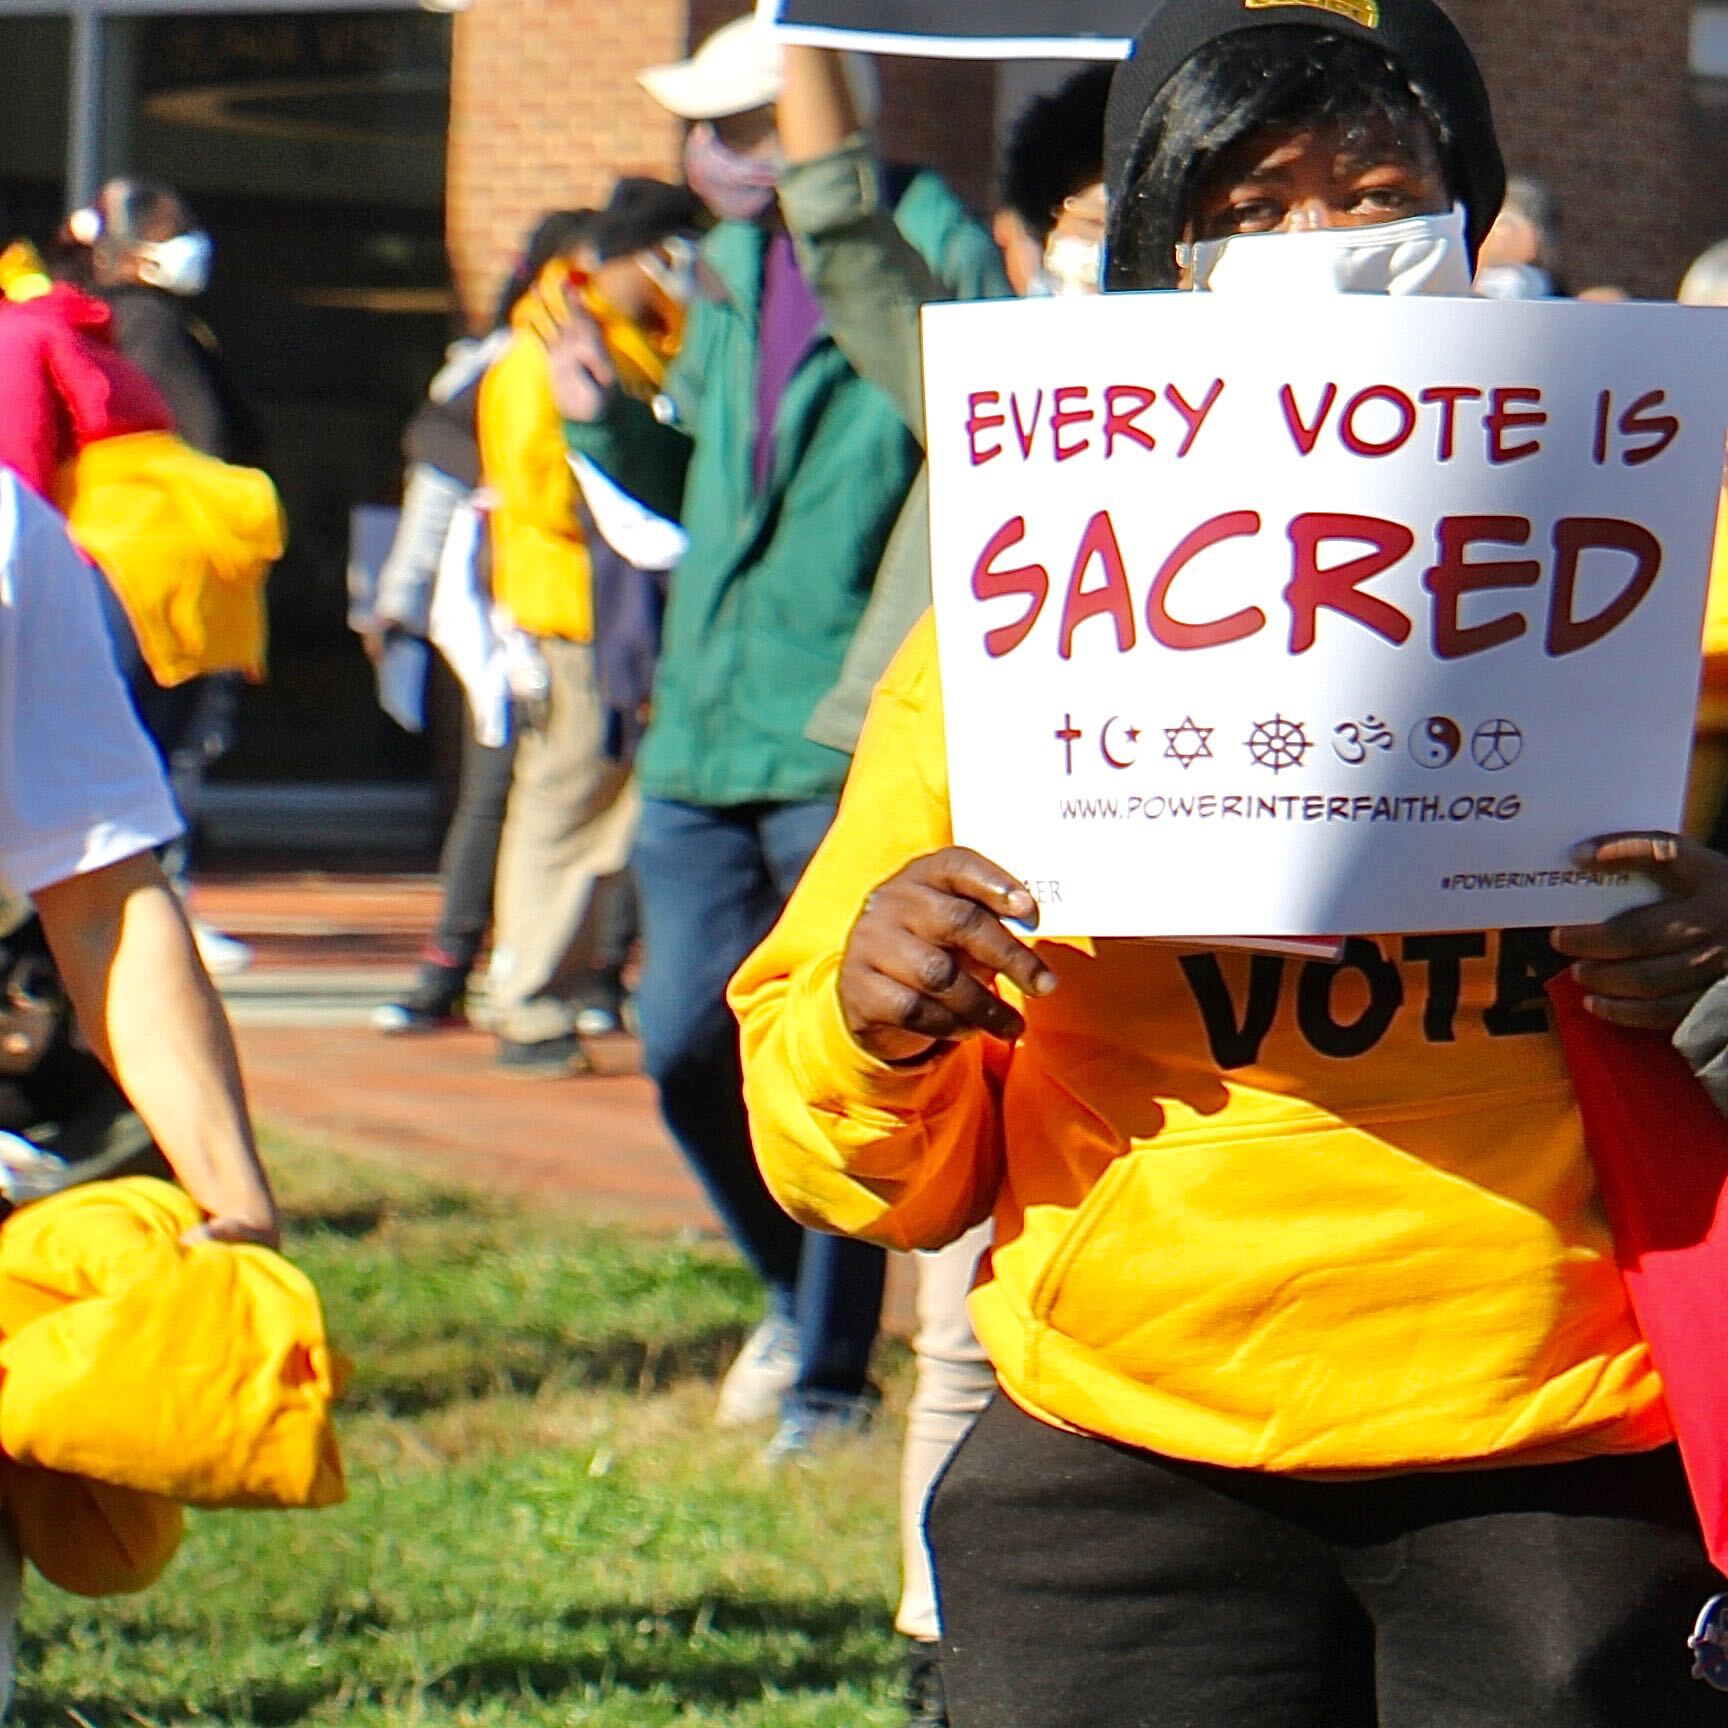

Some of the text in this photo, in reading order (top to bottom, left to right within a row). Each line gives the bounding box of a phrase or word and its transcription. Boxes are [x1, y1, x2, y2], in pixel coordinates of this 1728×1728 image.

[966, 378, 1680, 466] EVERY VOTE IS
[971, 509, 1662, 660] SACRED
[1060, 792, 1521, 822] WWW.POWERINTERFAITH.ORG
[1440, 870, 1631, 891] #POWERINTERFAITH
[1179, 932, 1552, 1071] VOTE
